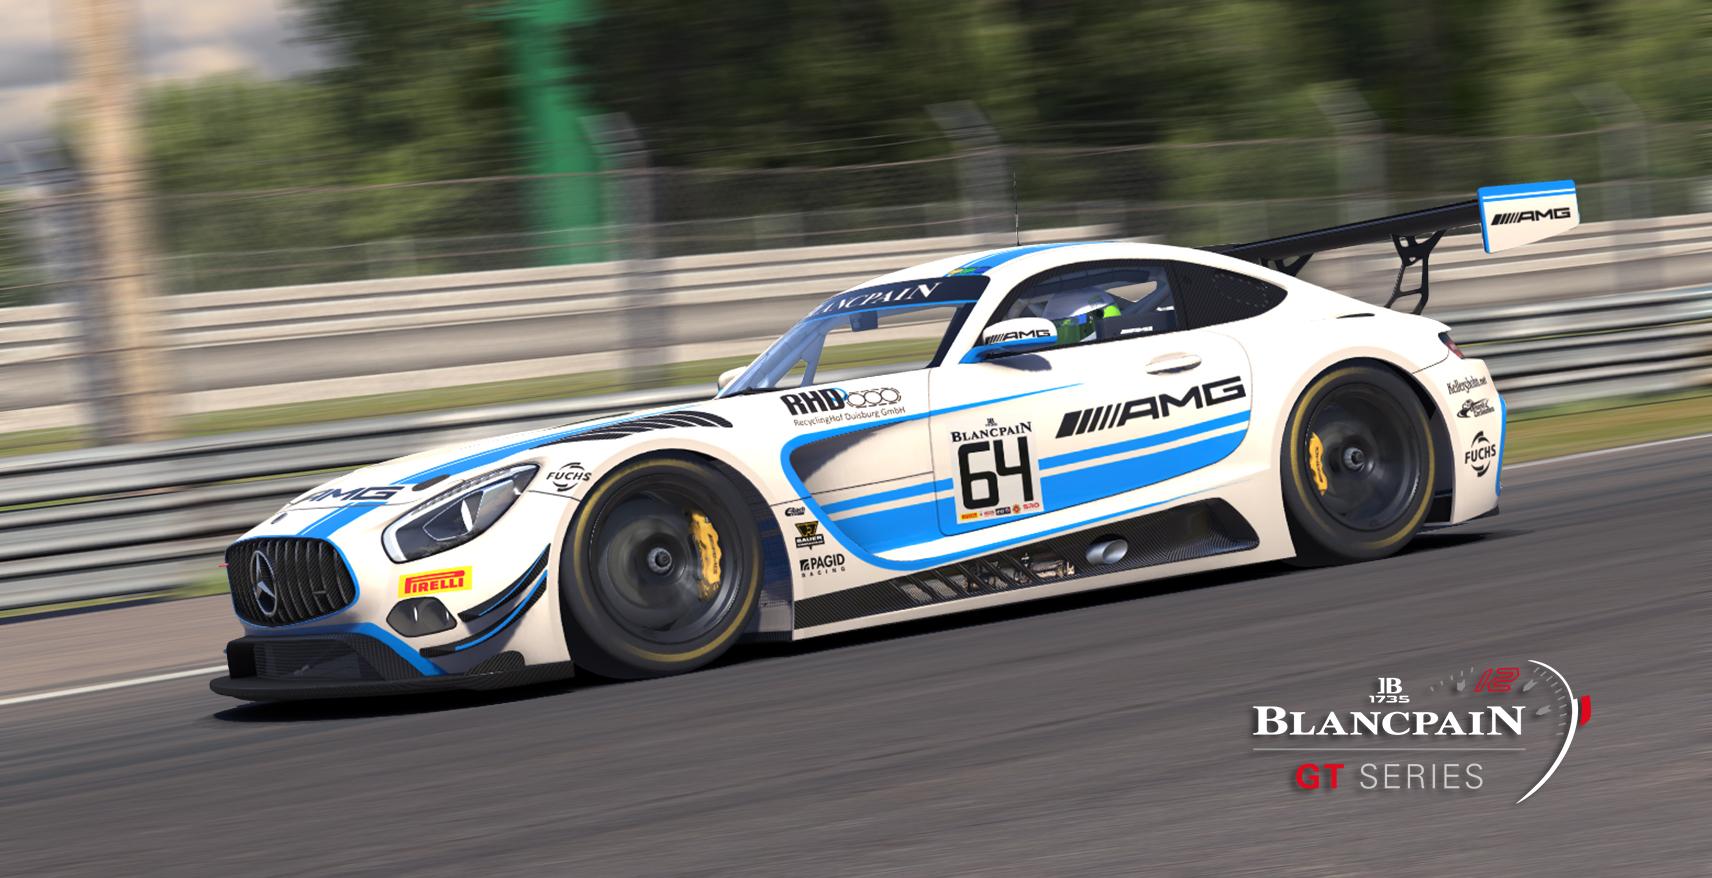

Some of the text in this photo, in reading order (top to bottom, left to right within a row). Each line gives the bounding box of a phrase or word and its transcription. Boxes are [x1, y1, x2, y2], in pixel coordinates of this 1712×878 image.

[1518, 207, 1571, 223] AMG
[1003, 329, 1050, 340] AMG
[780, 387, 846, 416] RHD
[1116, 375, 1247, 428] AMG
[844, 409, 881, 421] Duisburg
[880, 406, 906, 417] GmbH
[951, 421, 1033, 443] BLANCPAIN
[1465, 444, 1497, 464] FUCHS
[546, 471, 592, 481] FUCHS
[958, 436, 1034, 509] 64
[811, 554, 846, 570] PAGID
[802, 566, 846, 578] RACING
[404, 570, 465, 594] PIRELLI
